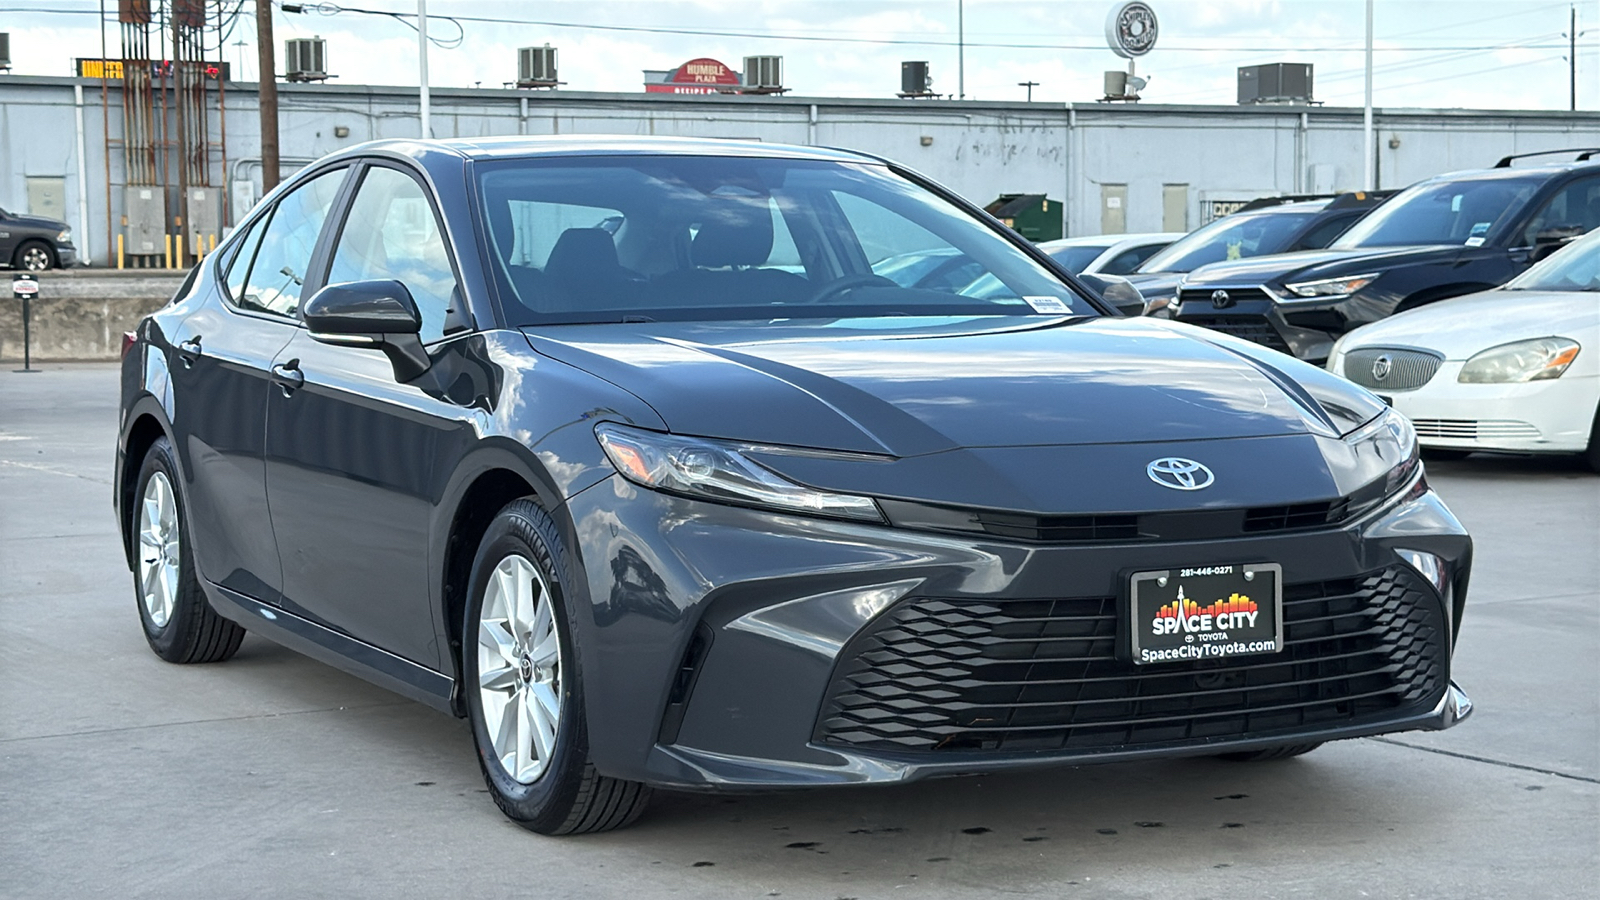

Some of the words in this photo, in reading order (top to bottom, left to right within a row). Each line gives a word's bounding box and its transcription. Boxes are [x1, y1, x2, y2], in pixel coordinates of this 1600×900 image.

[687, 64, 725, 76] HUMBLE
[1180, 566, 1232, 577] 281-446-0271
[1152, 614, 1212, 635] SPACE
[1216, 611, 1258, 629] CITY
[1198, 632, 1228, 641] TOYOTA
[1141, 640, 1275, 662] SpaceCityToyota.com
